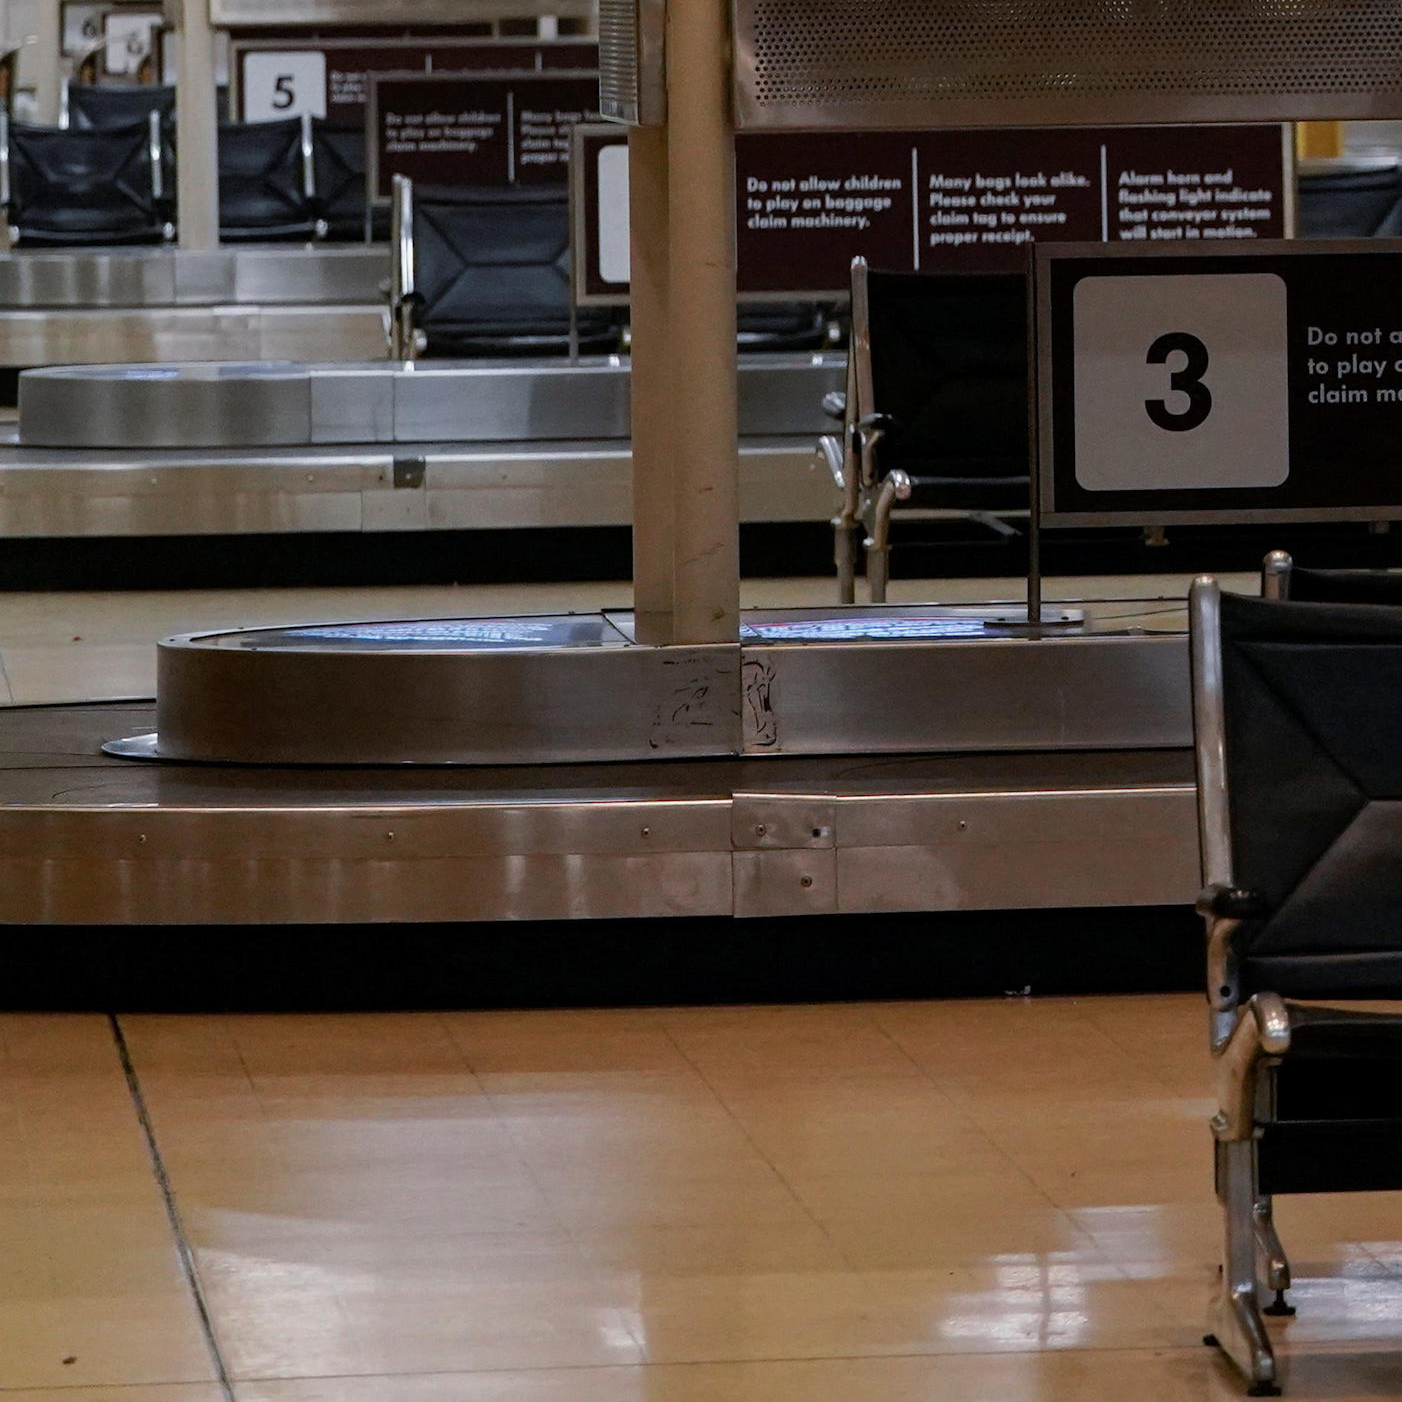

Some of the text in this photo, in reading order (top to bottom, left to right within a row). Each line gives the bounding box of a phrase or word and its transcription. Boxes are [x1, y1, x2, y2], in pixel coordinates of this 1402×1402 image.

[272, 75, 295, 109] 5
[747, 175, 901, 192] Do not allow children
[930, 175, 971, 190] Many
[976, 174, 1011, 191] bags
[1016, 172, 1046, 187] look
[748, 194, 891, 213] to play on baggage
[930, 192, 1056, 208] Please check your
[748, 212, 870, 229] claim machinery.
[930, 211, 1066, 227] claim tag to ensure
[930, 233, 977, 246] proper
[1308, 327, 1337, 345] Do
[1347, 328, 1382, 344] not
[1308, 359, 1328, 374] to
[1338, 354, 1386, 378] play
[1143, 332, 1213, 431] 3
[1309, 383, 1367, 403] claim
